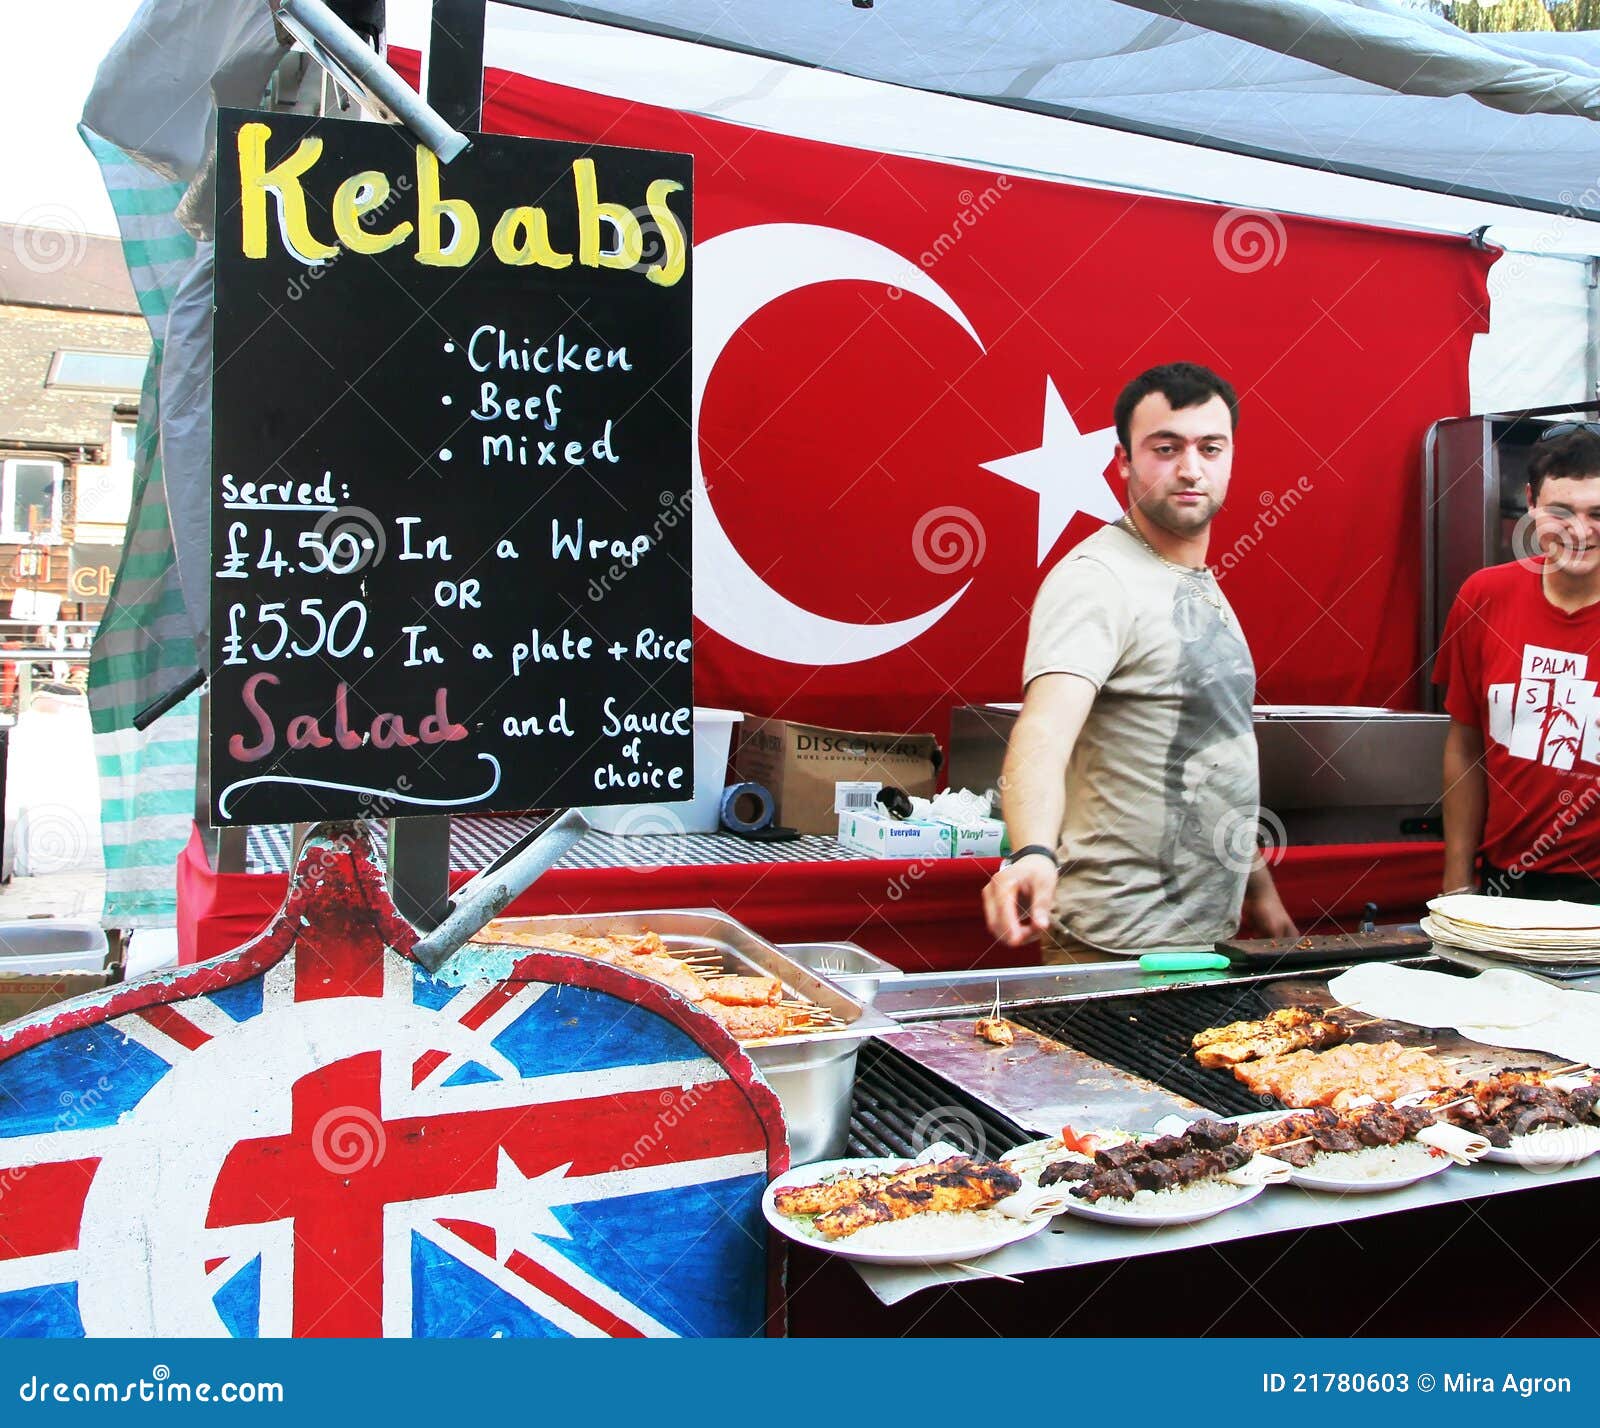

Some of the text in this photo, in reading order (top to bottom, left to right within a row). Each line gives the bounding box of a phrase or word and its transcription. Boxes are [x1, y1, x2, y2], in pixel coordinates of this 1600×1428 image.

[237, 123, 686, 287] Kebabs
[468, 325, 632, 373] Chicken
[471, 382, 562, 430] Beef
[395, 517, 650, 566] In a Wrap
[435, 578, 481, 609] OR
[402, 626, 443, 667] In
[473, 641, 493, 660] a
[512, 629, 593, 676] plate
[1531, 656, 1576, 676] PALM
[228, 672, 468, 762] Salad
[503, 697, 691, 737] and Sauce
[622, 737, 642, 764] of
[890, 827, 921, 838] Everyday
[960, 828, 984, 841] Vinyl
